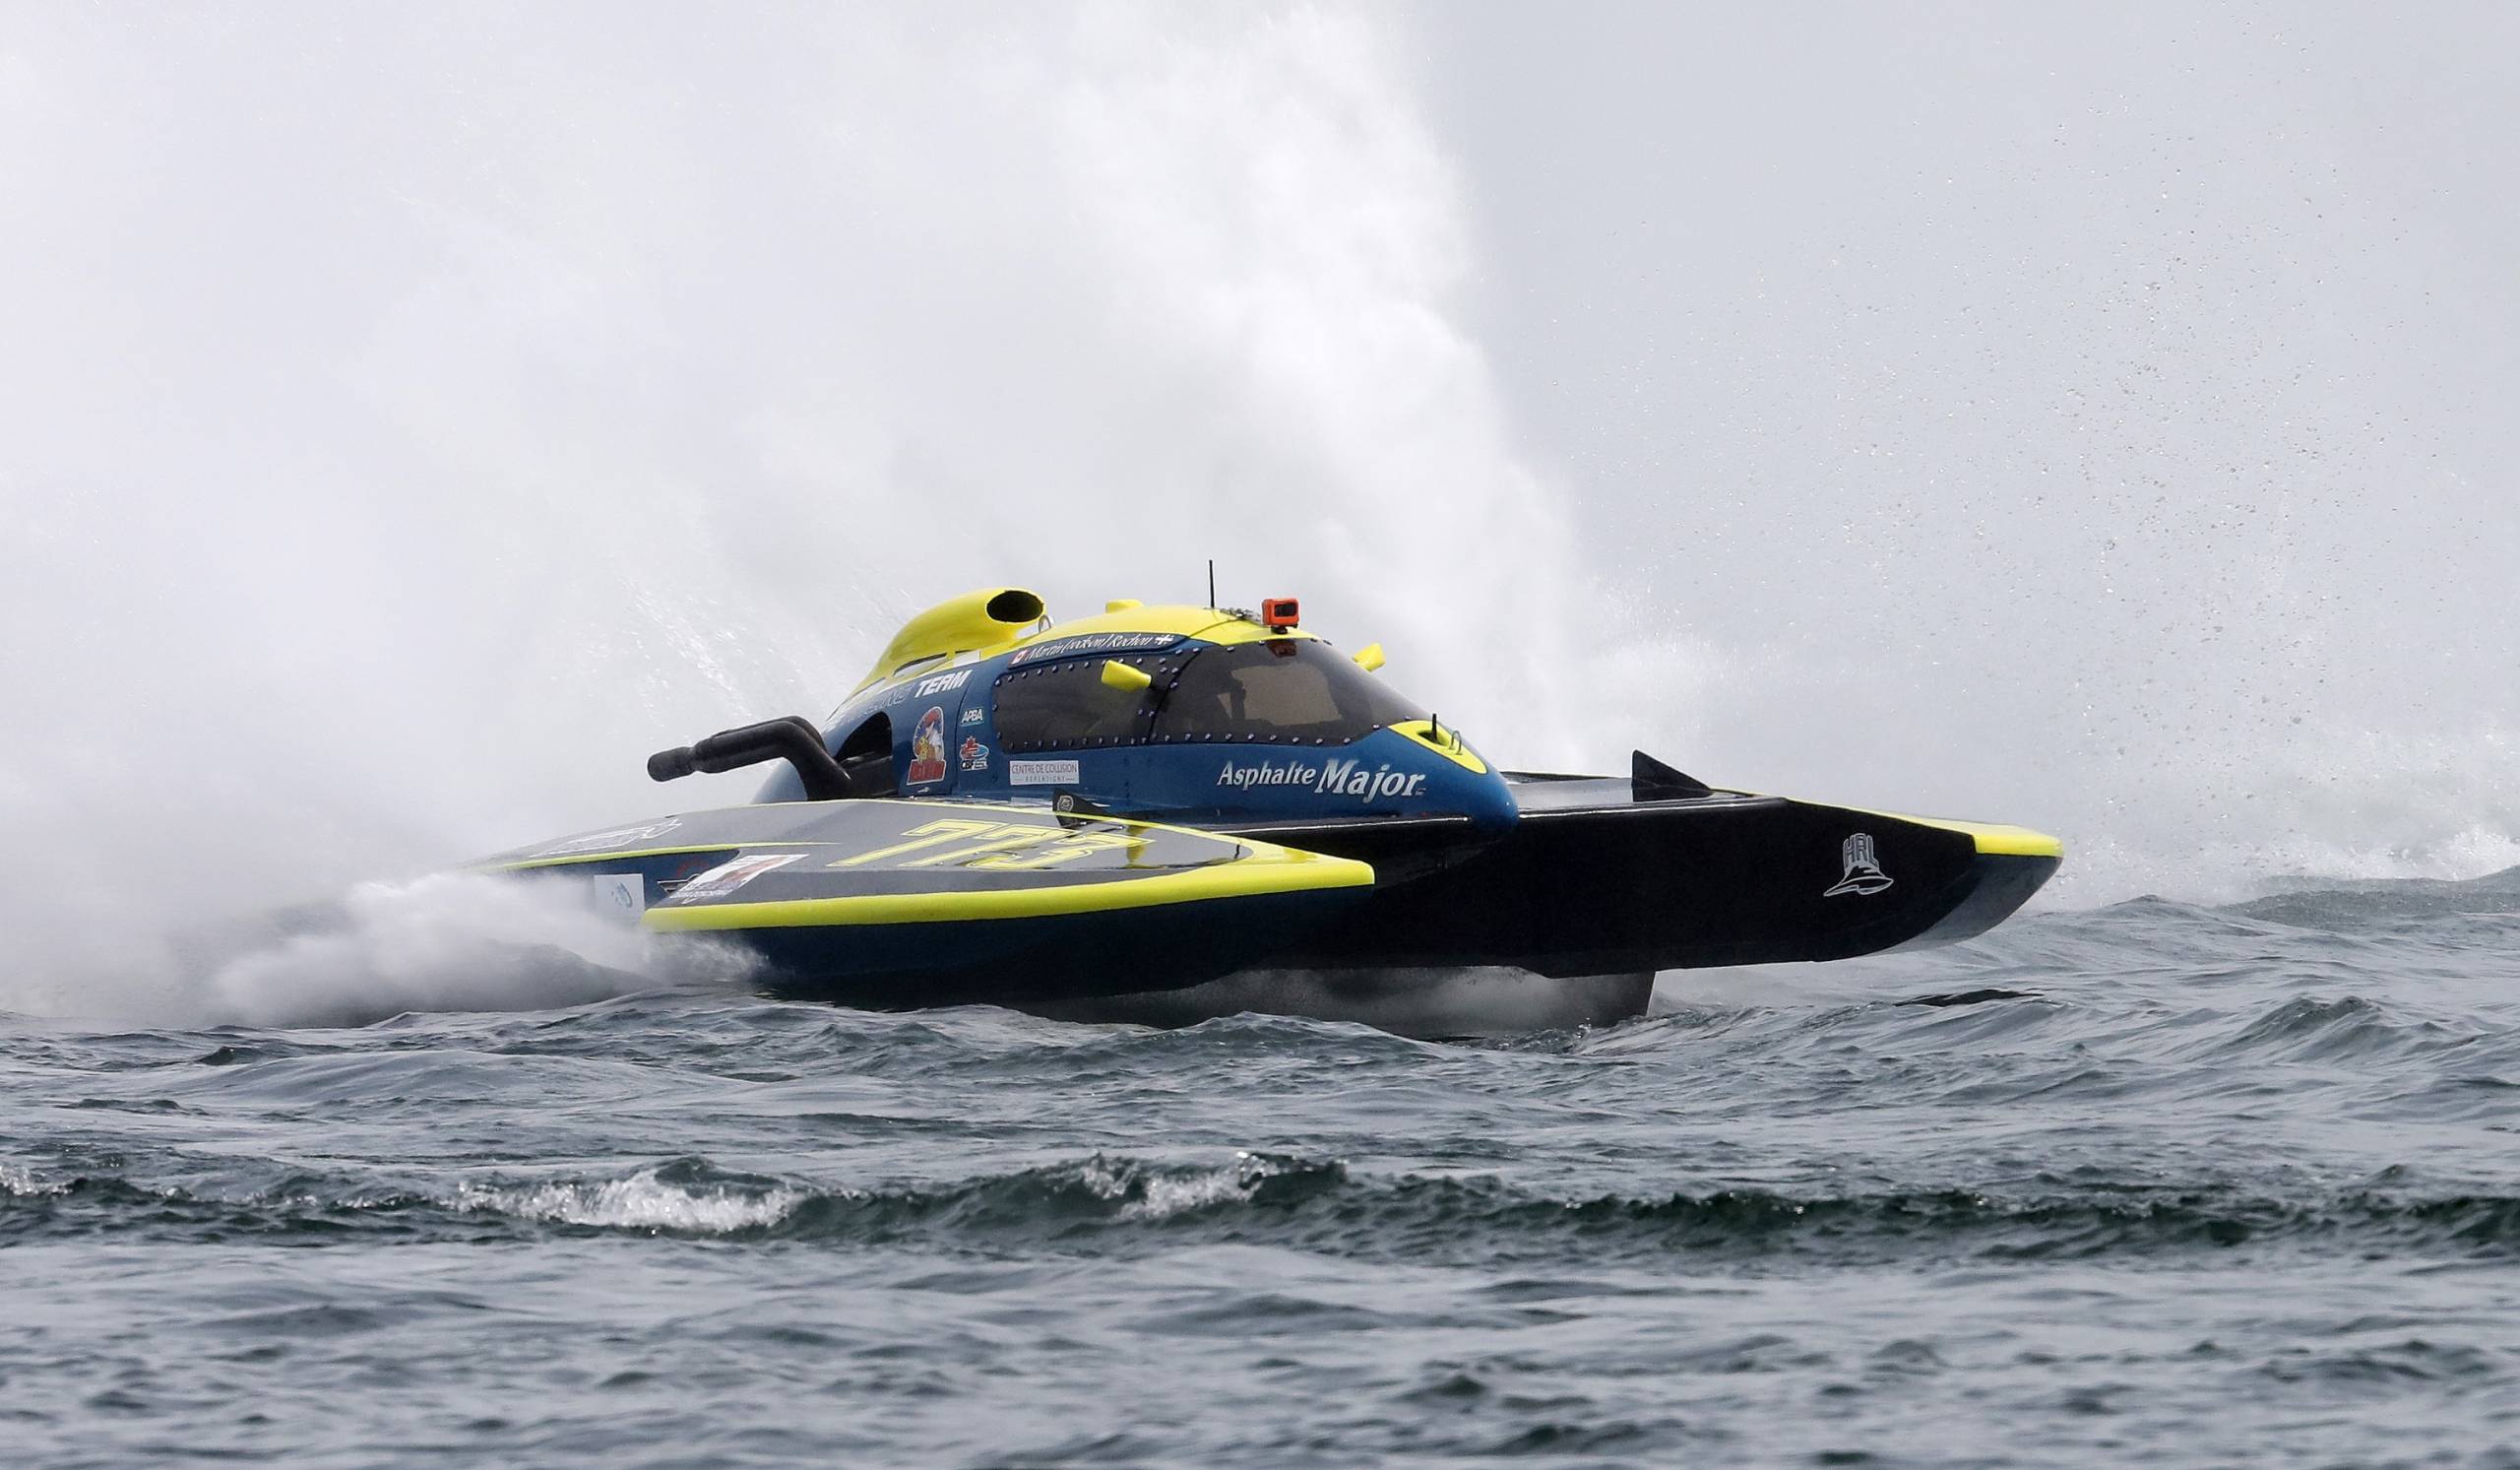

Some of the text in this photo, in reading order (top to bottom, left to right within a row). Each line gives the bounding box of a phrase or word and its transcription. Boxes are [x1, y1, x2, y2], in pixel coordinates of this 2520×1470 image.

[914, 670, 973, 698] TEAM
[961, 709, 983, 724] APBA
[1012, 764, 1077, 774] CENTRE DE COLLISION
[1217, 758, 1425, 803] Asphalte Major
[825, 819, 1157, 870] 773
